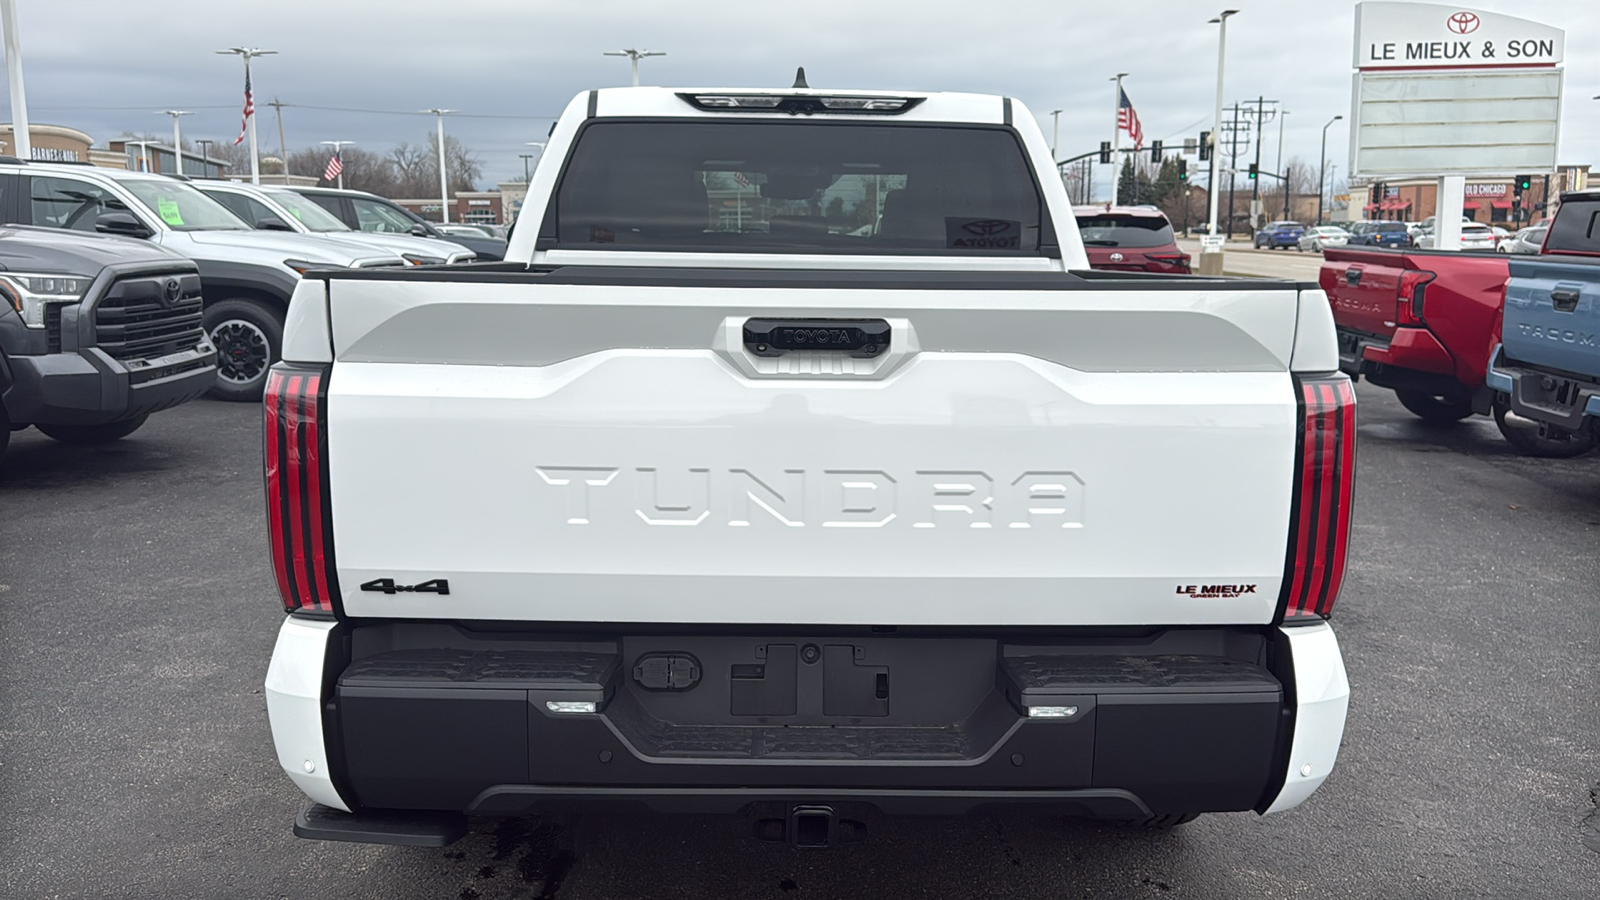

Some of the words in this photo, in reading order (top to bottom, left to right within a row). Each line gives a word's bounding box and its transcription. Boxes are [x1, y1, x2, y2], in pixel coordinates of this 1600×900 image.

[1371, 43, 1396, 60] LE
[1406, 41, 1472, 60] MIEUX
[1481, 41, 1495, 58] &
[1507, 40, 1553, 58] SON
[1466, 184, 1478, 194] OLD
[1479, 184, 1506, 195] CHICAGO
[783, 329, 851, 343] TOYOTA
[1519, 323, 1600, 348] TACOM
[534, 465, 1086, 529] TUNDRA
[1176, 585, 1197, 594] LE
[1201, 584, 1257, 594] MIEUX
